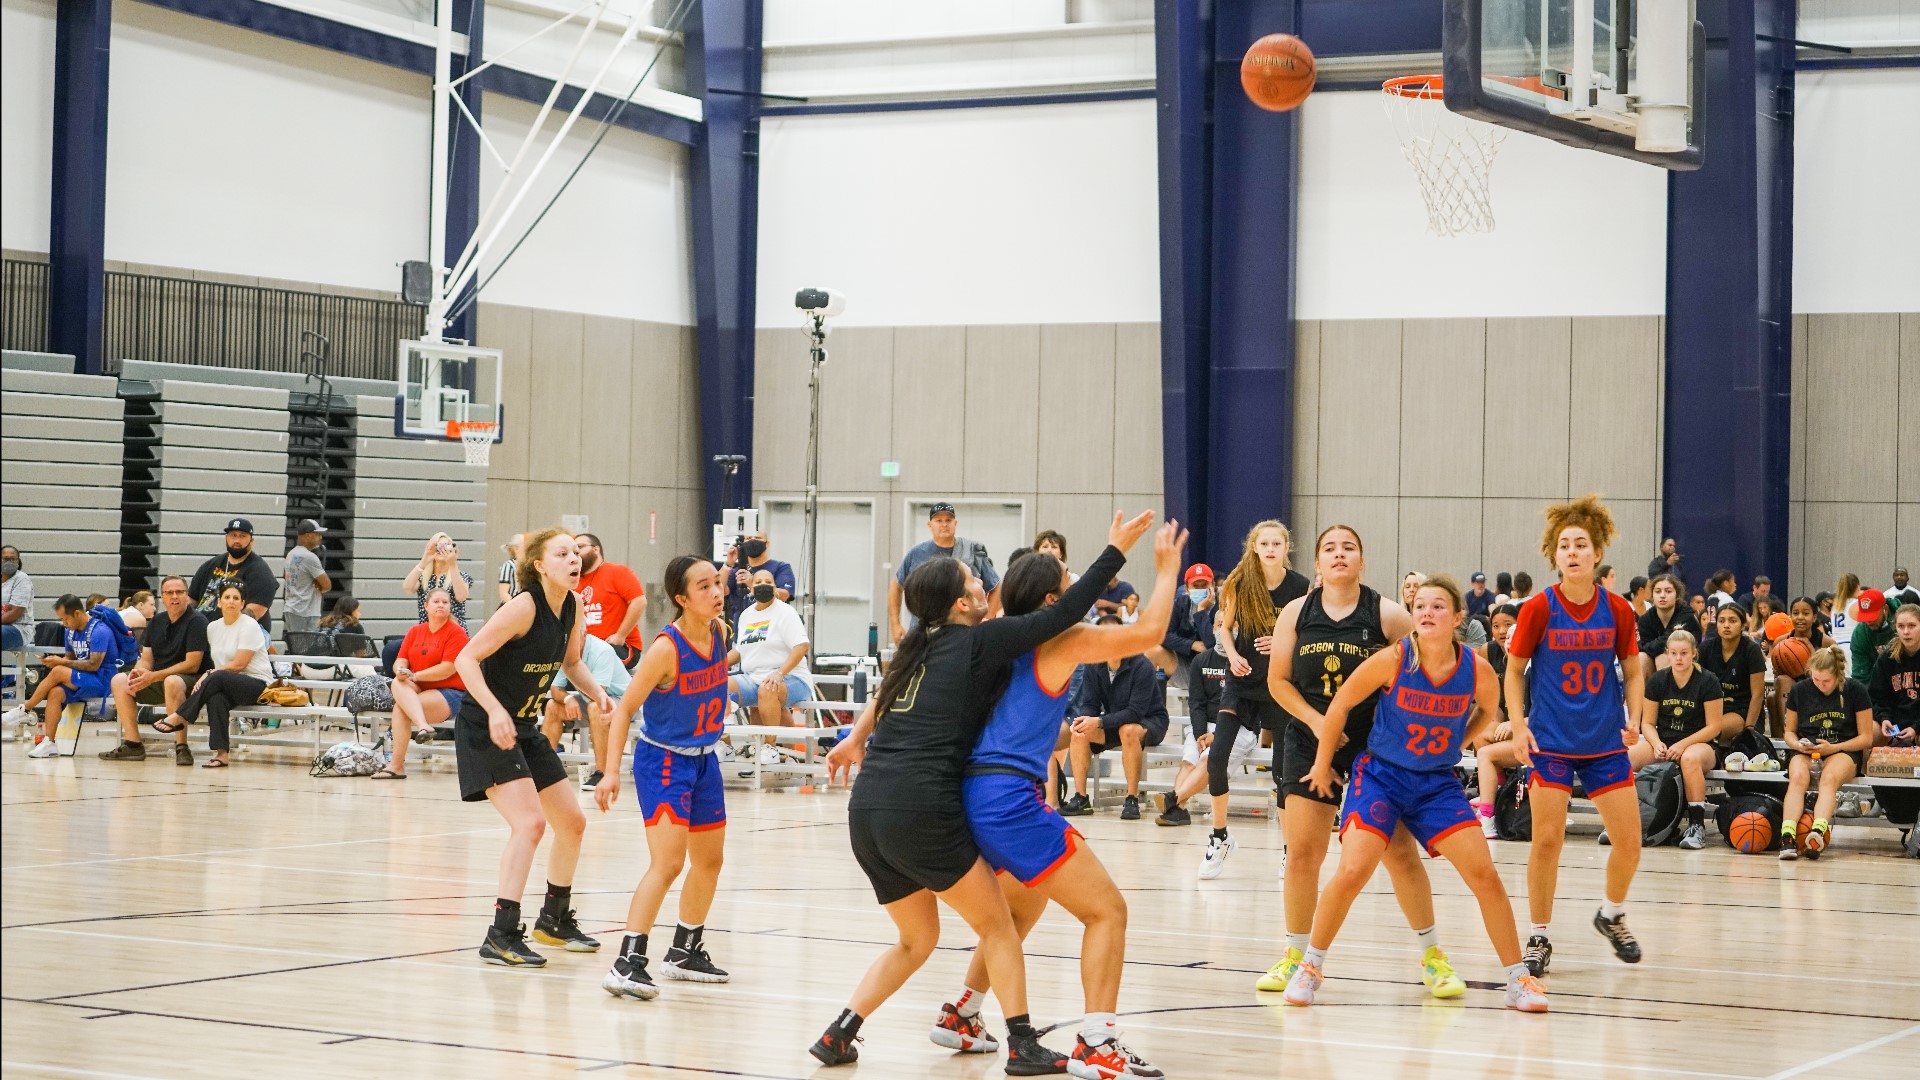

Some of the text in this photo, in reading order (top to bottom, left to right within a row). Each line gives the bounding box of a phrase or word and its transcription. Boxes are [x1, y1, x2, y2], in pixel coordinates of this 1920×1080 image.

[1834, 613, 1845, 628] 12
[1555, 632, 1611, 647] MOVE AS ONE
[686, 673, 708, 691] MOVE
[1561, 660, 1605, 695] 30
[516, 693, 547, 718] 15
[1404, 692, 1465, 713] MOVE AS ONE
[693, 697, 723, 736] 12
[1405, 723, 1451, 756] 23
